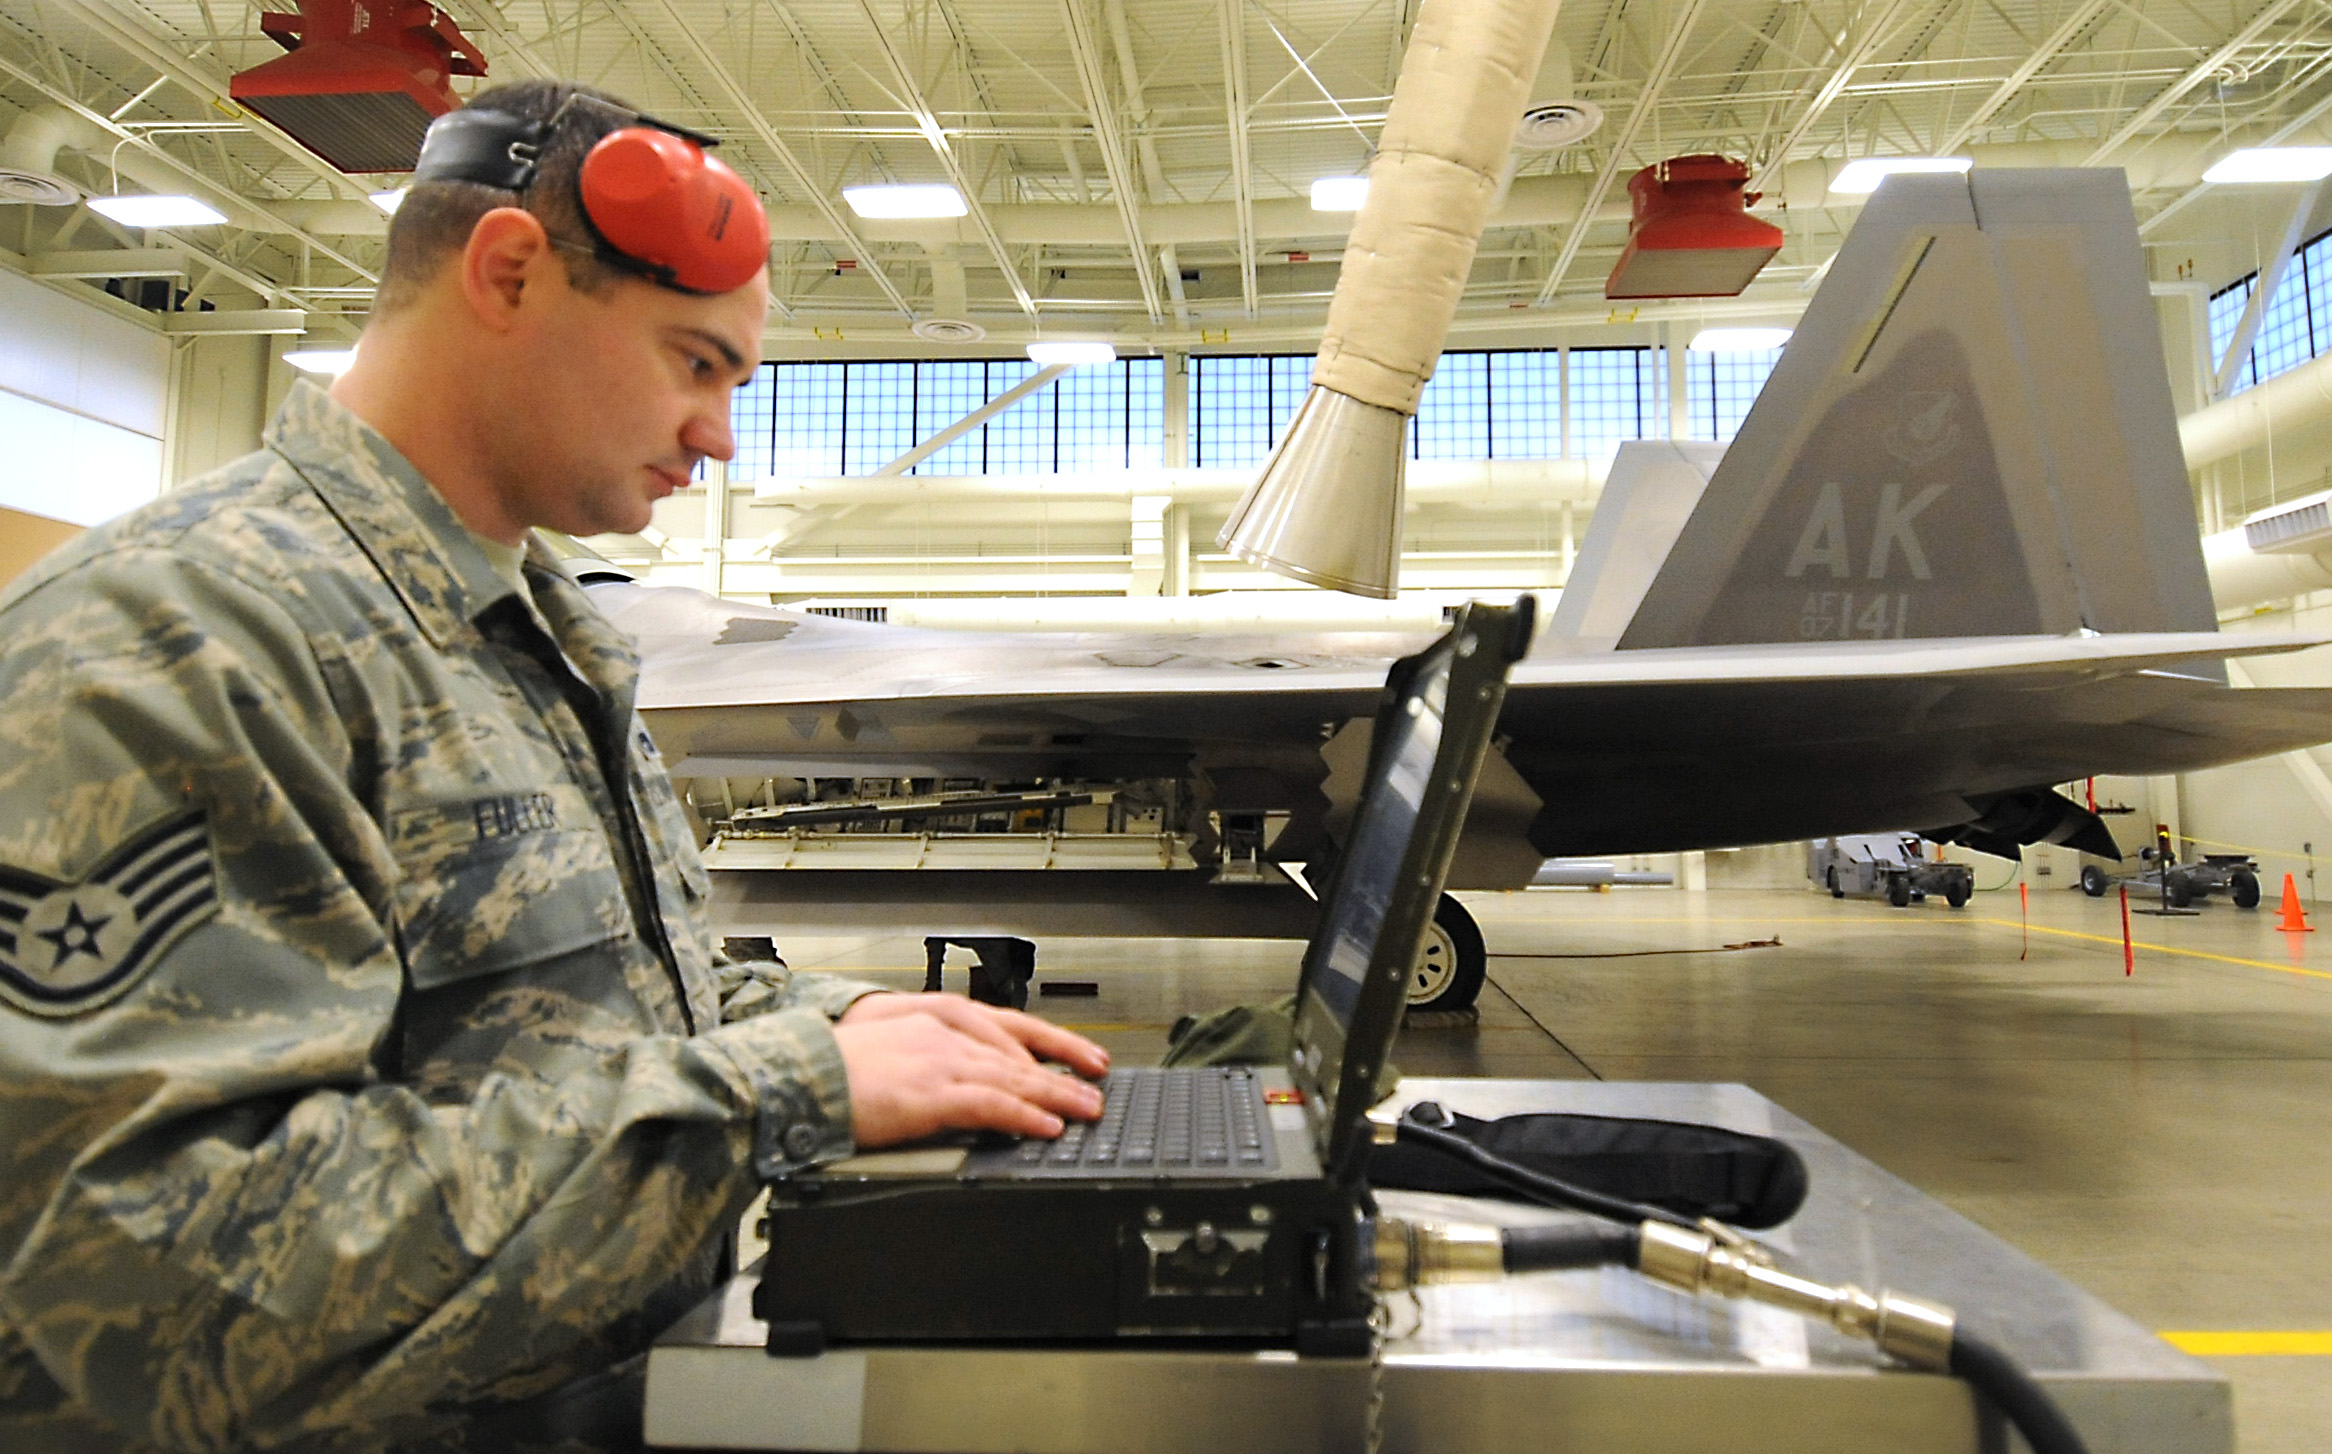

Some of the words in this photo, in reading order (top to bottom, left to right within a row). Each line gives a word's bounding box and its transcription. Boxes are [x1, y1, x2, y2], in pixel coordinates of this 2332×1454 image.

[1784, 482, 1950, 580] AK
[1801, 591, 1839, 614] AF
[1838, 592, 1911, 639] 141
